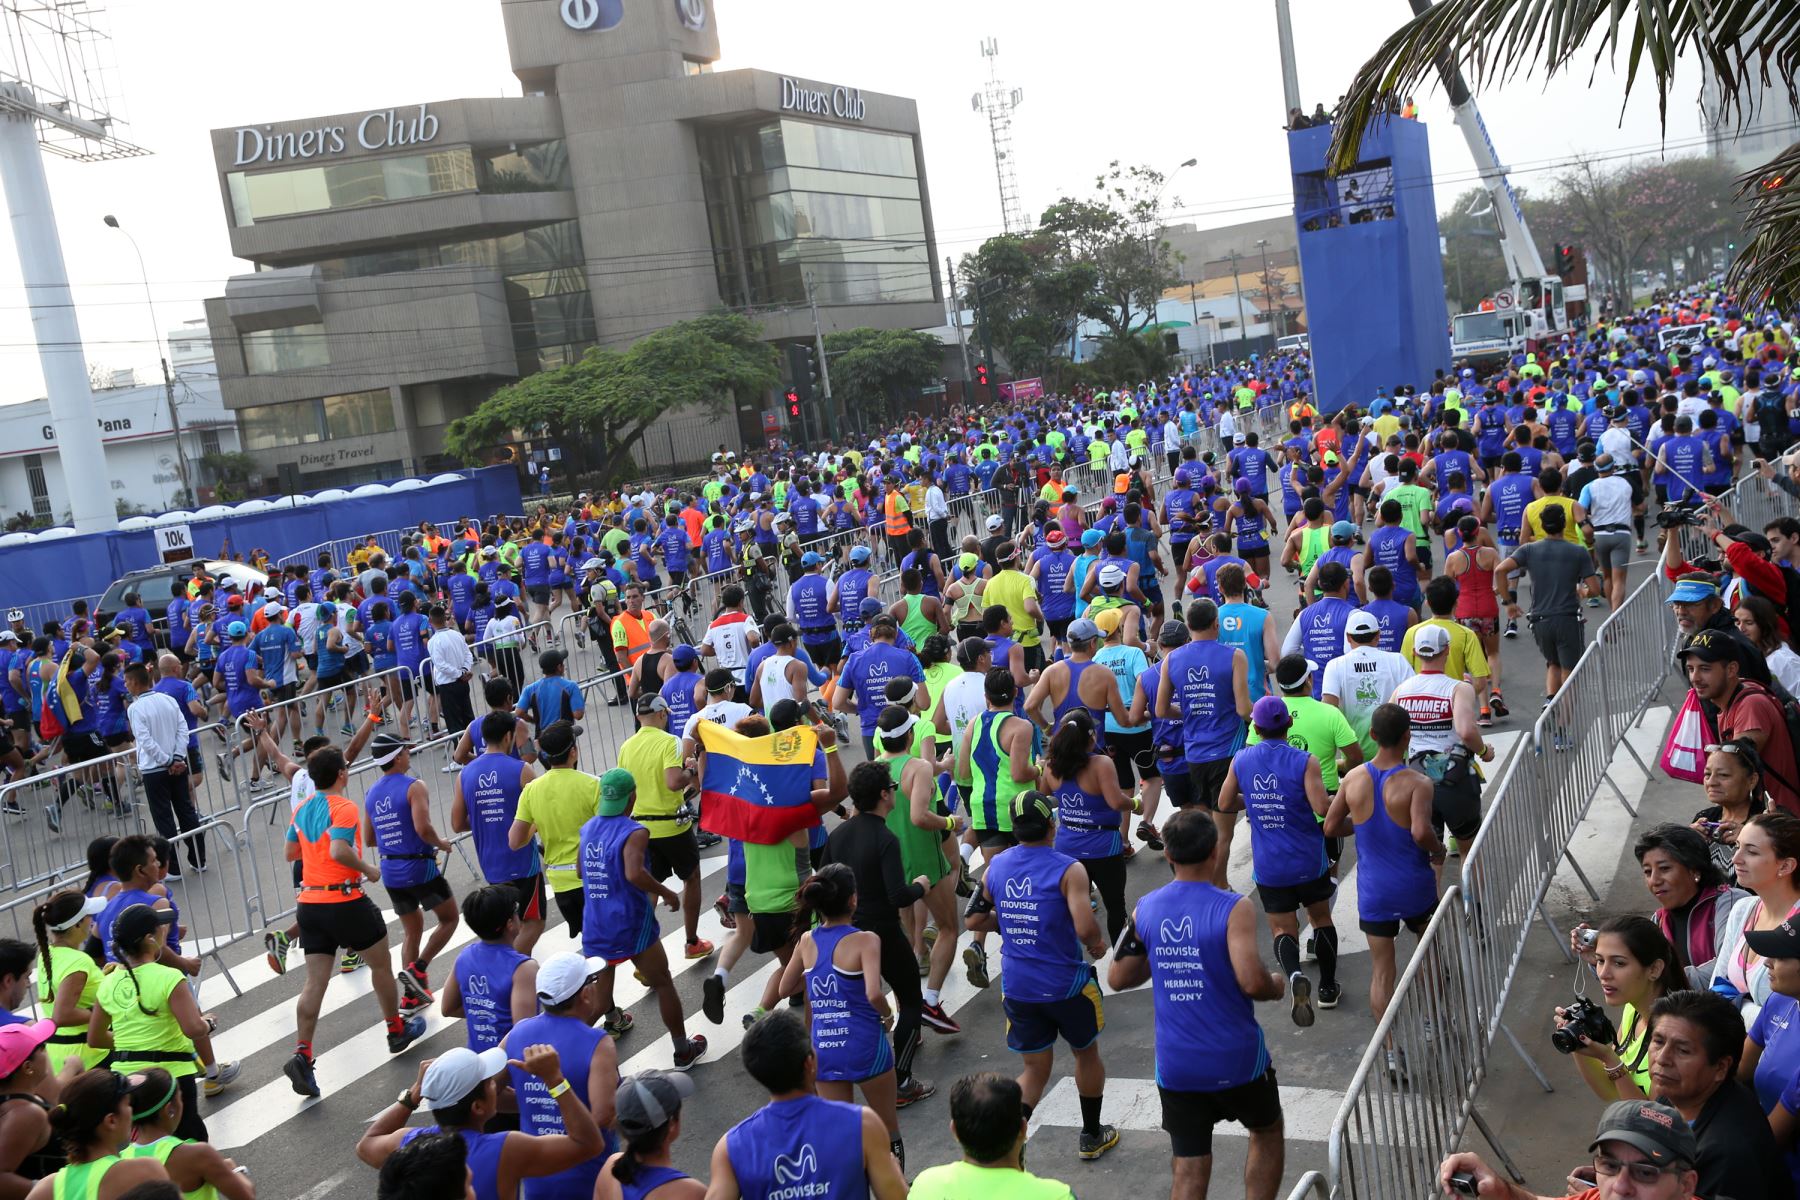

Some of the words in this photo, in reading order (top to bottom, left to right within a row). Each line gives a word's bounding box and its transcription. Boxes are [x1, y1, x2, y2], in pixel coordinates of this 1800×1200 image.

[782, 77, 830, 115] Diners
[834, 86, 866, 120] Club
[234, 125, 345, 166] Diners
[358, 104, 438, 150] Club
[300, 452, 335, 465] Diners
[338, 446, 374, 460] Travel
[165, 531, 186, 547] 10k
[1354, 662, 1377, 672] WILLY
[1400, 699, 1449, 713] HAMMER
[476, 788, 502, 796] movistar
[1251, 793, 1284, 801] movistar
[374, 812, 398, 822] movistar
[1000, 900, 1038, 910] movistar
[1156, 946, 1200, 956] movistar
[1164, 980, 1204, 988] HERBALIFE
[1170, 993, 1202, 1001] SONY
[465, 996, 496, 1010] movistar
[811, 999, 846, 1008] movistar
[816, 1027, 848, 1037] HERBALIFE
[818, 1040, 846, 1048] SONY
[768, 1182, 830, 1200] movistar
